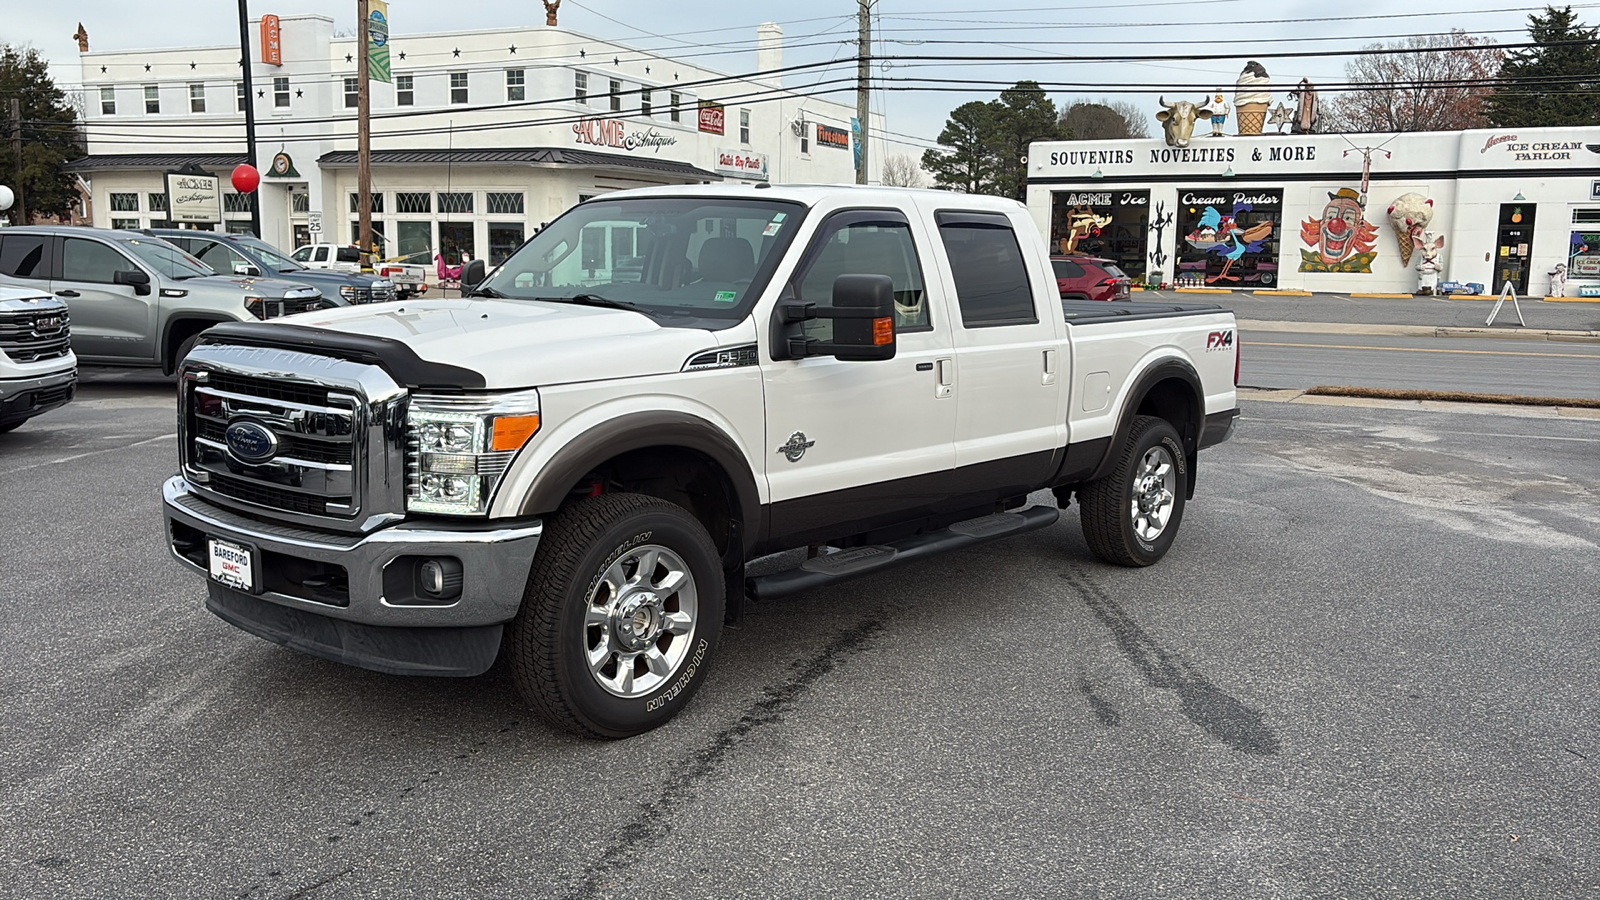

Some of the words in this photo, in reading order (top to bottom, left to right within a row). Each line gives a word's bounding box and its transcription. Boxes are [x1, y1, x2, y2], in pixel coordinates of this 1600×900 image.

[269, 18, 279, 61] ACME
[572, 115, 625, 149] ACME
[817, 125, 849, 145] Firestone
[1506, 143, 1530, 152] ICE
[1532, 141, 1583, 151] CREAM
[719, 153, 734, 166] Dutch
[735, 155, 744, 170] Boy
[1050, 149, 1134, 166] SOUVENIRS
[1150, 147, 1236, 163] NOVELTIES
[1251, 147, 1262, 162] &
[1268, 146, 1316, 161] MORE
[1515, 152, 1571, 161] PARLOR
[177, 178, 213, 190] ACME
[1067, 193, 1112, 206] ACME
[1120, 192, 1147, 206] Ice
[1182, 192, 1226, 205] Cream
[1232, 192, 1280, 205] Parlor
[309, 222, 321, 231] 25
[1206, 330, 1233, 348] FX4
[213, 545, 249, 567] BAREFORD
[222, 561, 241, 574] GMC
[584, 531, 652, 604] MICHELIN
[646, 638, 709, 712] MICHELIN
